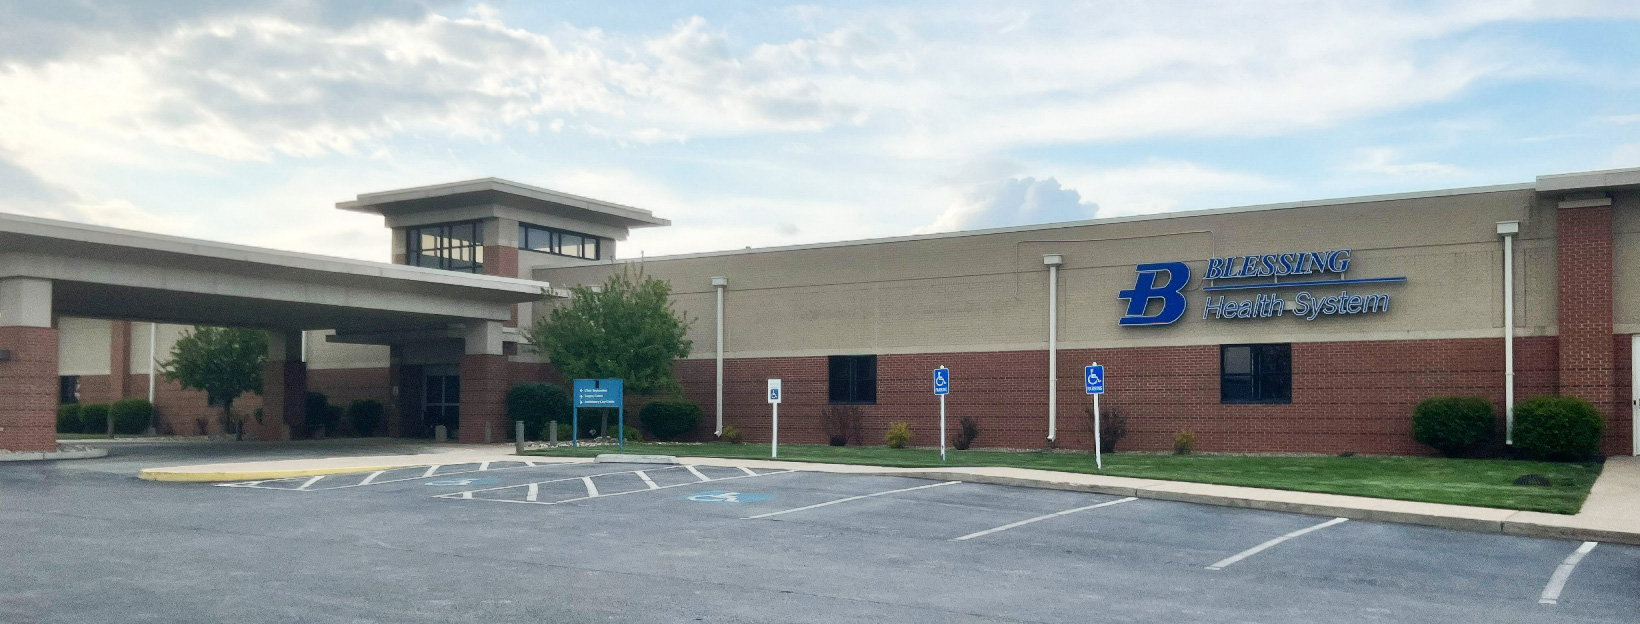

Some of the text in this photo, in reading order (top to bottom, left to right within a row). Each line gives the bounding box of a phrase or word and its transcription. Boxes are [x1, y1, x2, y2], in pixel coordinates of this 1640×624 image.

[1203, 249, 1351, 279] BLESSING
[1203, 291, 1389, 320] Health System
